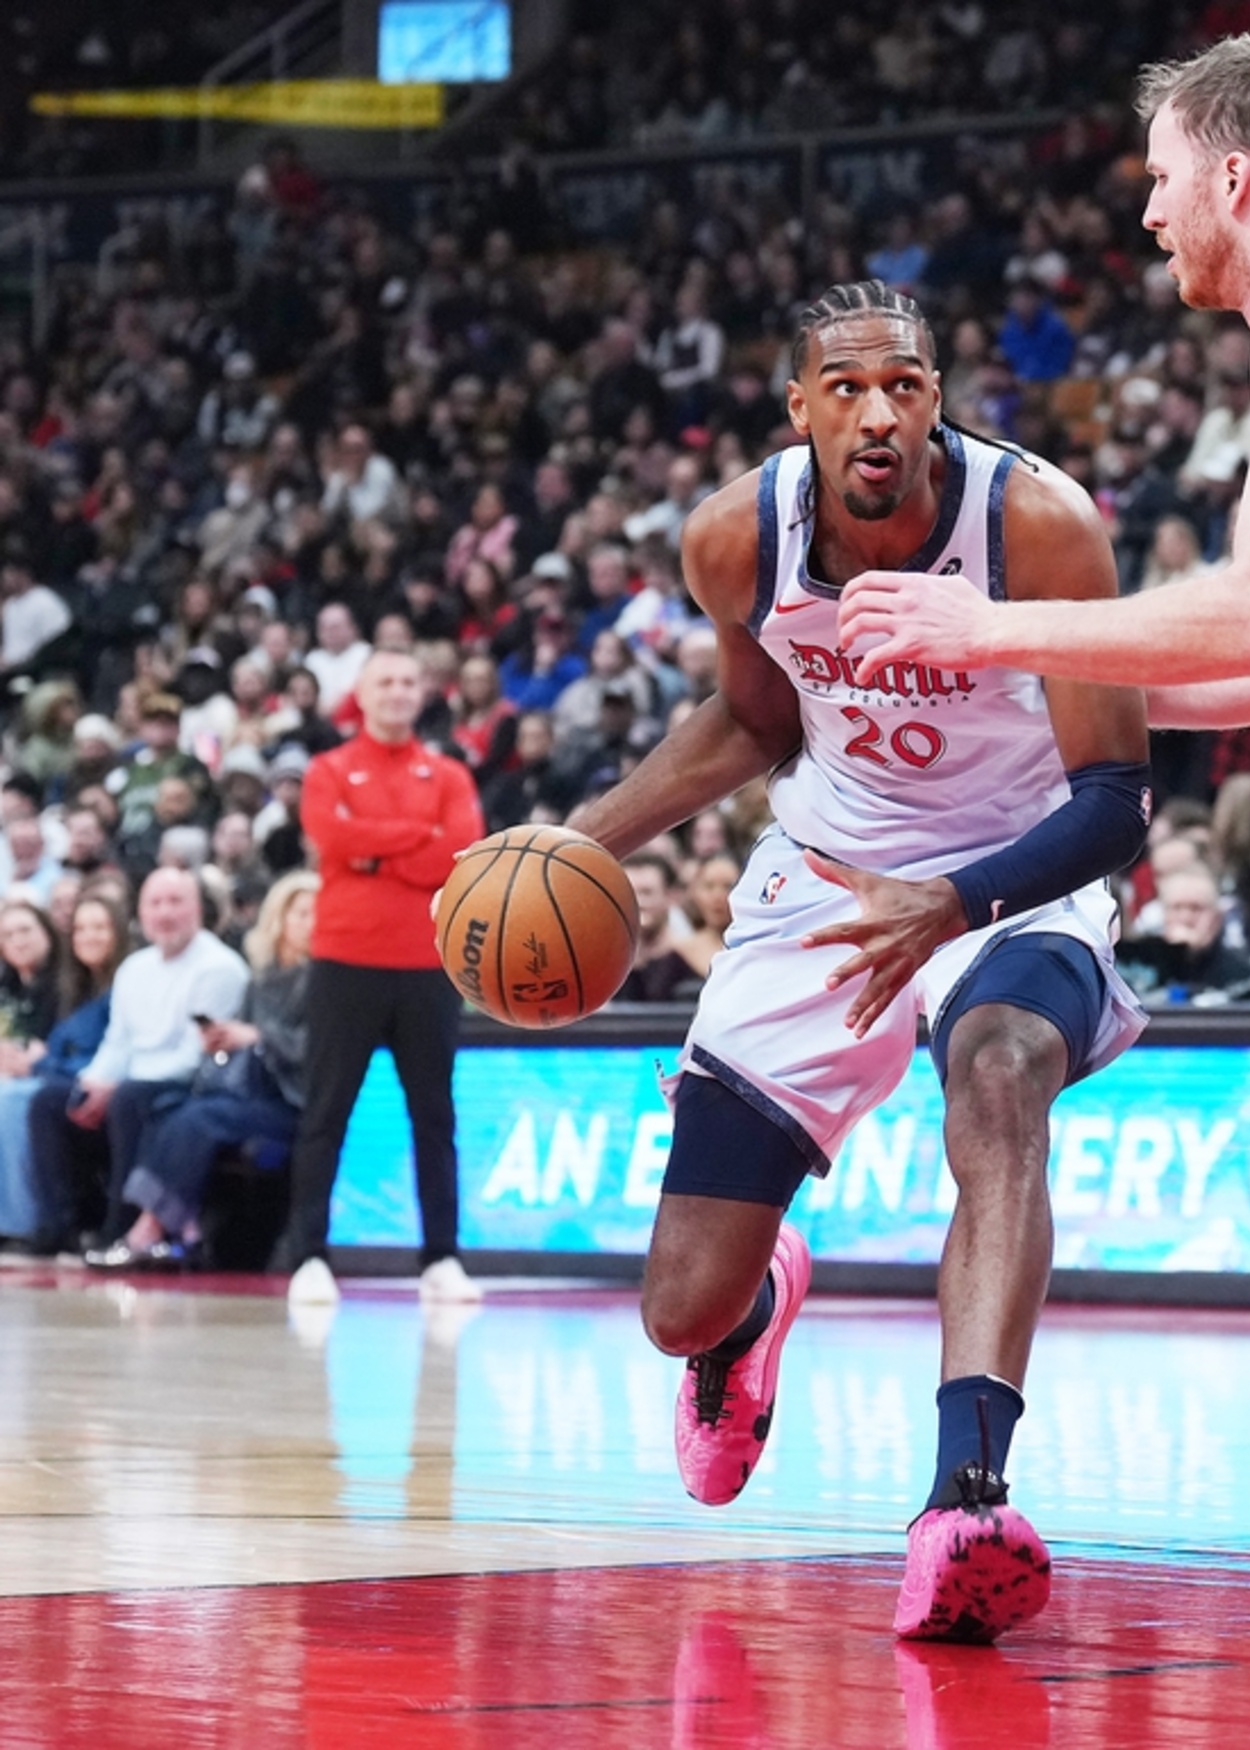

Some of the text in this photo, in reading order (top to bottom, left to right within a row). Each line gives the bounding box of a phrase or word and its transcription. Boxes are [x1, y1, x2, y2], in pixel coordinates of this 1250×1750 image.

[840, 706, 948, 769] 20
[456, 918, 490, 1004] lson
[482, 1109, 610, 1207] AN
